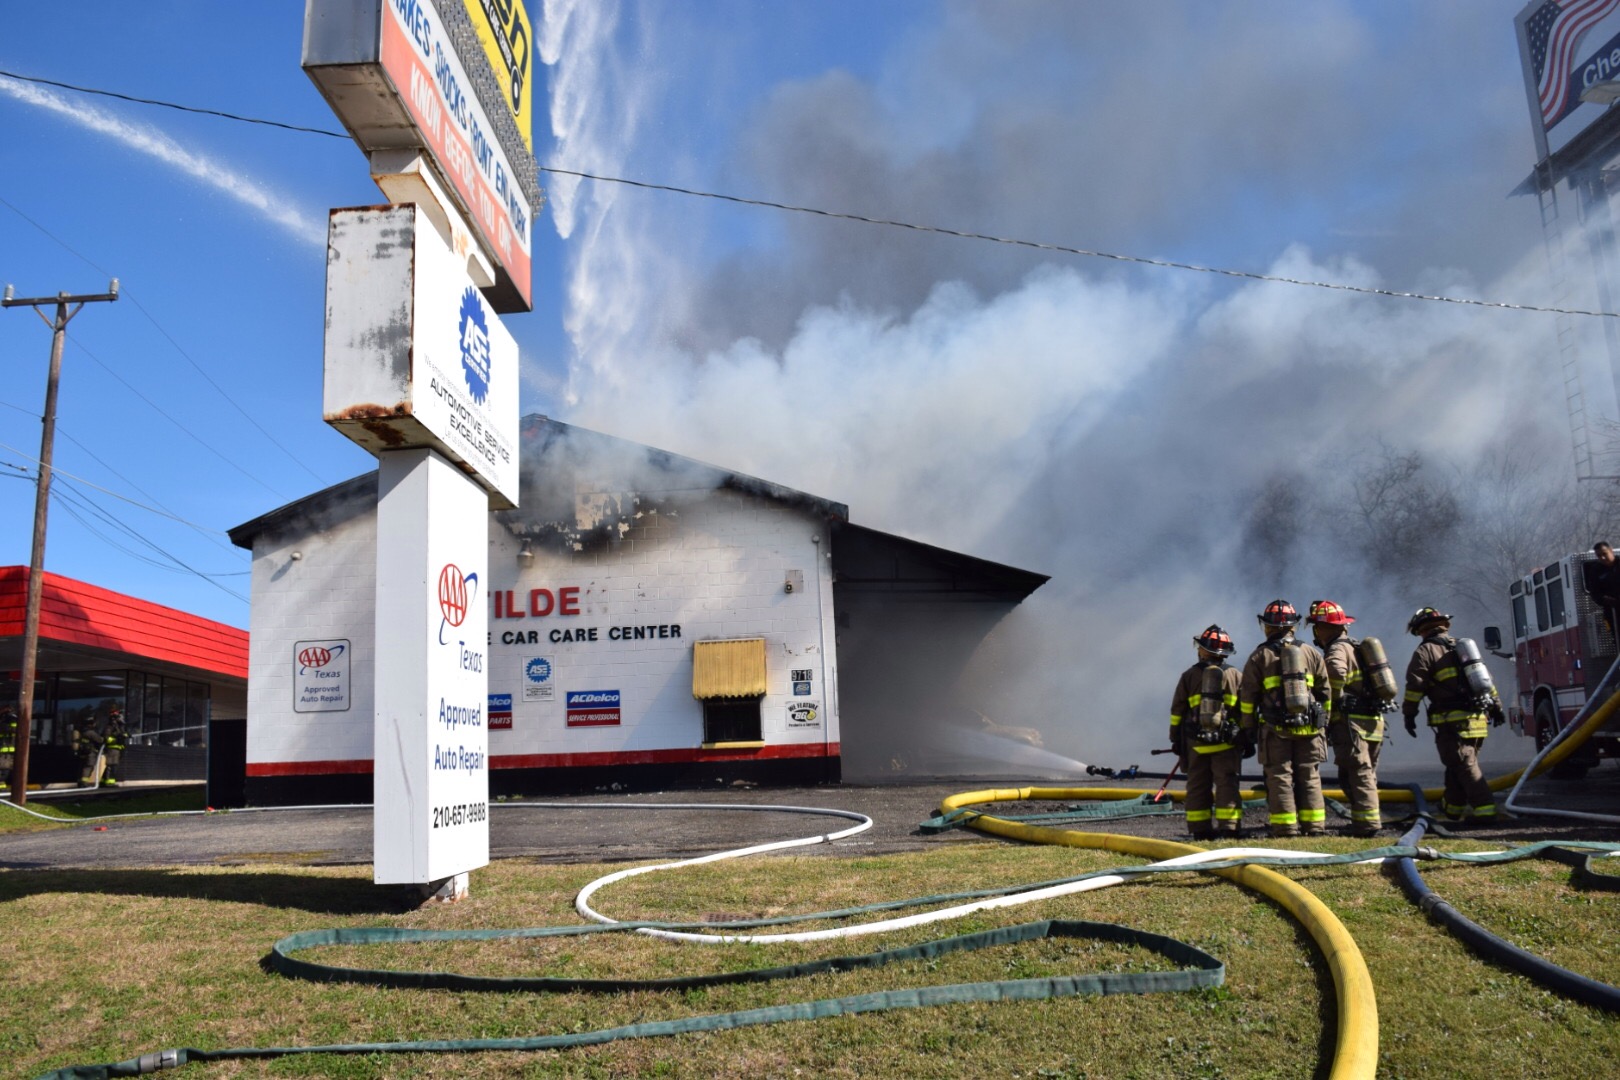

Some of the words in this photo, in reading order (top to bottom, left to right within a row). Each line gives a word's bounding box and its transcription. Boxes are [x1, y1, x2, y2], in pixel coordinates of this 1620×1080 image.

[395, 0, 431, 57] AKES
[435, 41, 467, 130] SHOCKS
[469, 112, 493, 179] FRONT
[411, 62, 441, 142] KNOW
[445, 122, 476, 203] BEFORE
[478, 183, 494, 234] YOU
[463, 315, 487, 373] ASE
[430, 378, 482, 436] AUTOMOTIVE
[485, 430, 510, 464] SERVICE
[450, 414, 496, 466] EXCELLENCE
[440, 564, 466, 626] AAA
[488, 587, 580, 618] ILDE
[502, 631, 538, 645] CAR
[549, 627, 598, 643] CARE
[608, 624, 681, 640] CENTER
[300, 647, 330, 668] AAA
[459, 640, 482, 673] Texas
[530, 665, 547, 674] ASE
[304, 685, 340, 694] Approved
[314, 670, 341, 679] Texas
[320, 694, 343, 703] Repair
[570, 693, 619, 703] ACDelco
[439, 697, 481, 731] Approved
[489, 716, 511, 725] PARTS
[434, 744, 457, 770] Auto
[459, 745, 484, 776] Repair
[433, 802, 486, 828] 210-657-9988
